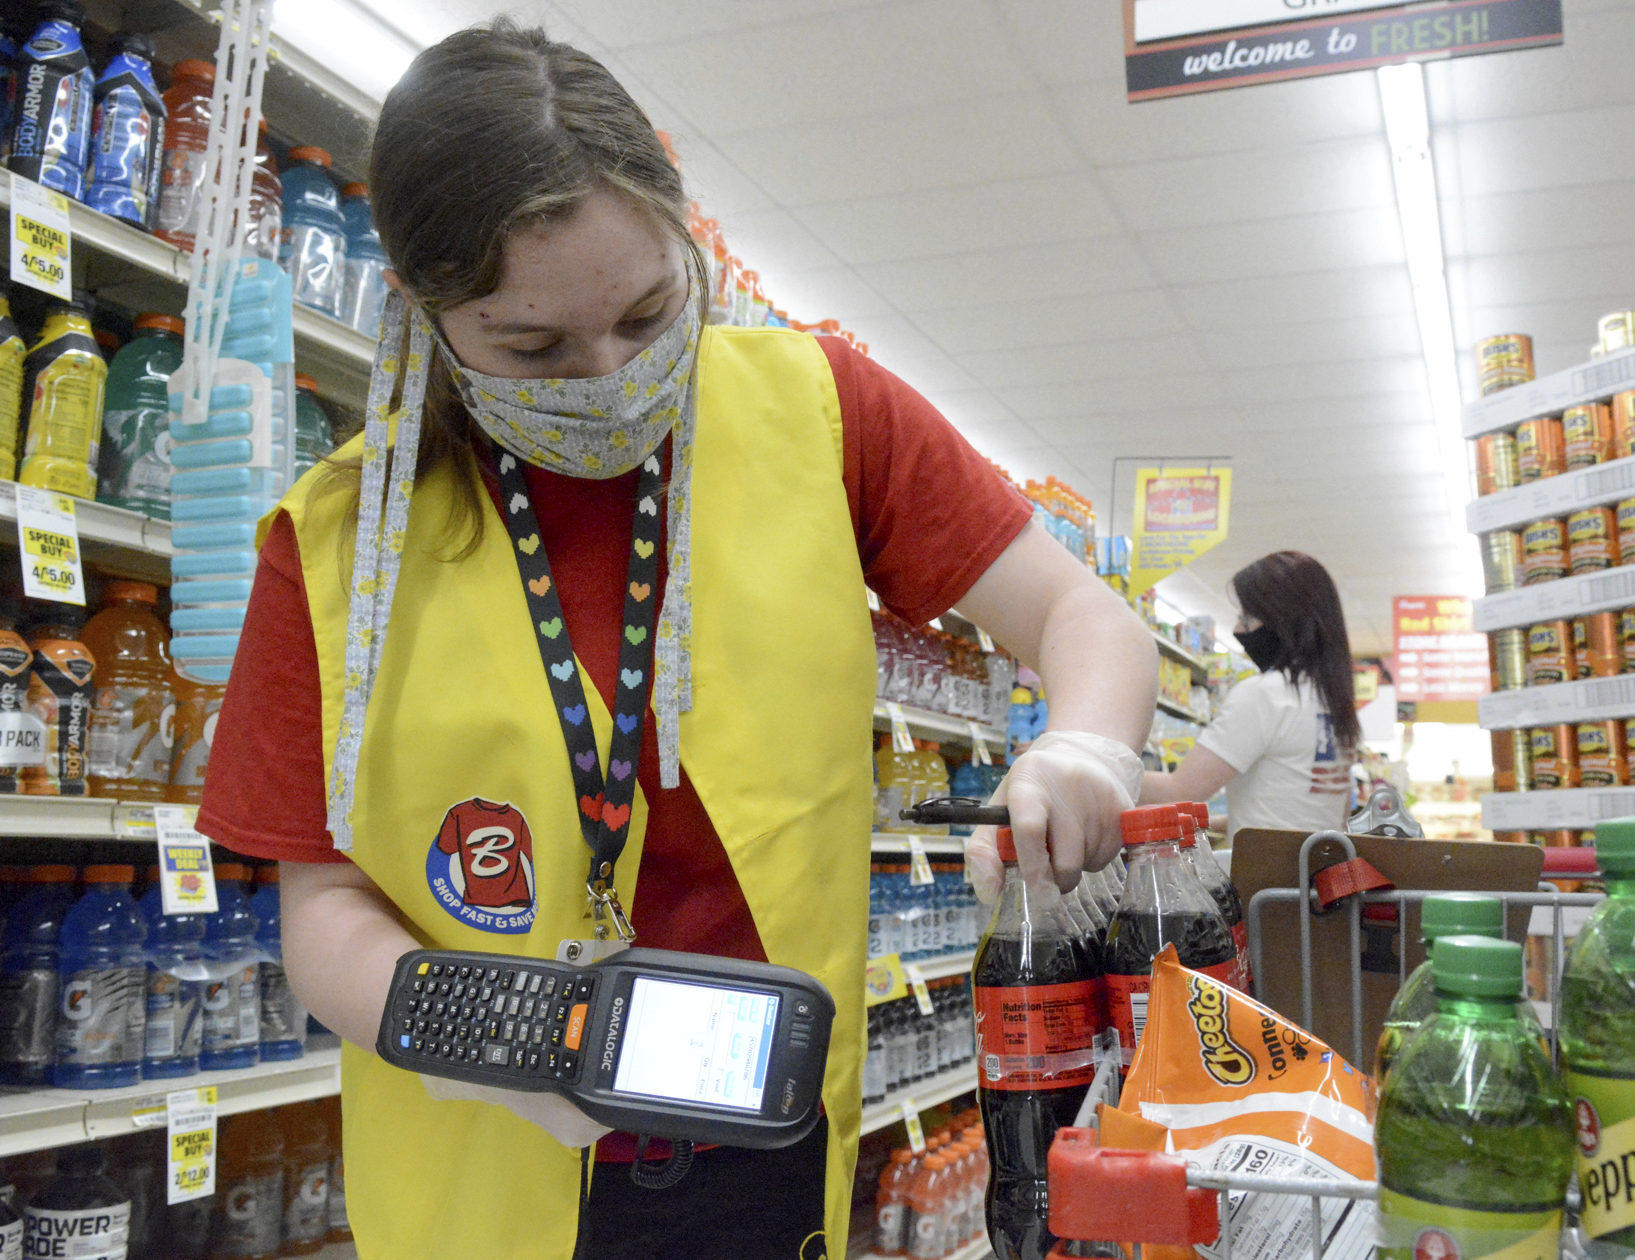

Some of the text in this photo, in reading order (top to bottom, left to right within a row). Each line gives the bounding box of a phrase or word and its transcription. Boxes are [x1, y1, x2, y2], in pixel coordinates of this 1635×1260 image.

[1183, 10, 1490, 77] welcome to FRESH!
[17, 64, 47, 157] BODYARMOR
[21, 219, 64, 245] SPECIAL
[32, 234, 55, 250] BUY
[29, 531, 72, 549] SPECIAL
[40, 544, 63, 557] BUY
[6, 730, 41, 748] PACK
[433, 877, 534, 929] SHOP FAST & SAVE
[1002, 1002, 1042, 1012] Nutrition
[1003, 1012, 1027, 1022] Facts
[570, 1016, 581, 1038] SCAN
[1189, 977, 1255, 1086] Cheetos
[601, 1006, 623, 1072] DATALOGIC
[175, 1131, 210, 1148] SPECIAL
[184, 1144, 202, 1157] BUY
[1245, 1149, 1268, 1173] 160
[24, 1213, 111, 1238] POWER
